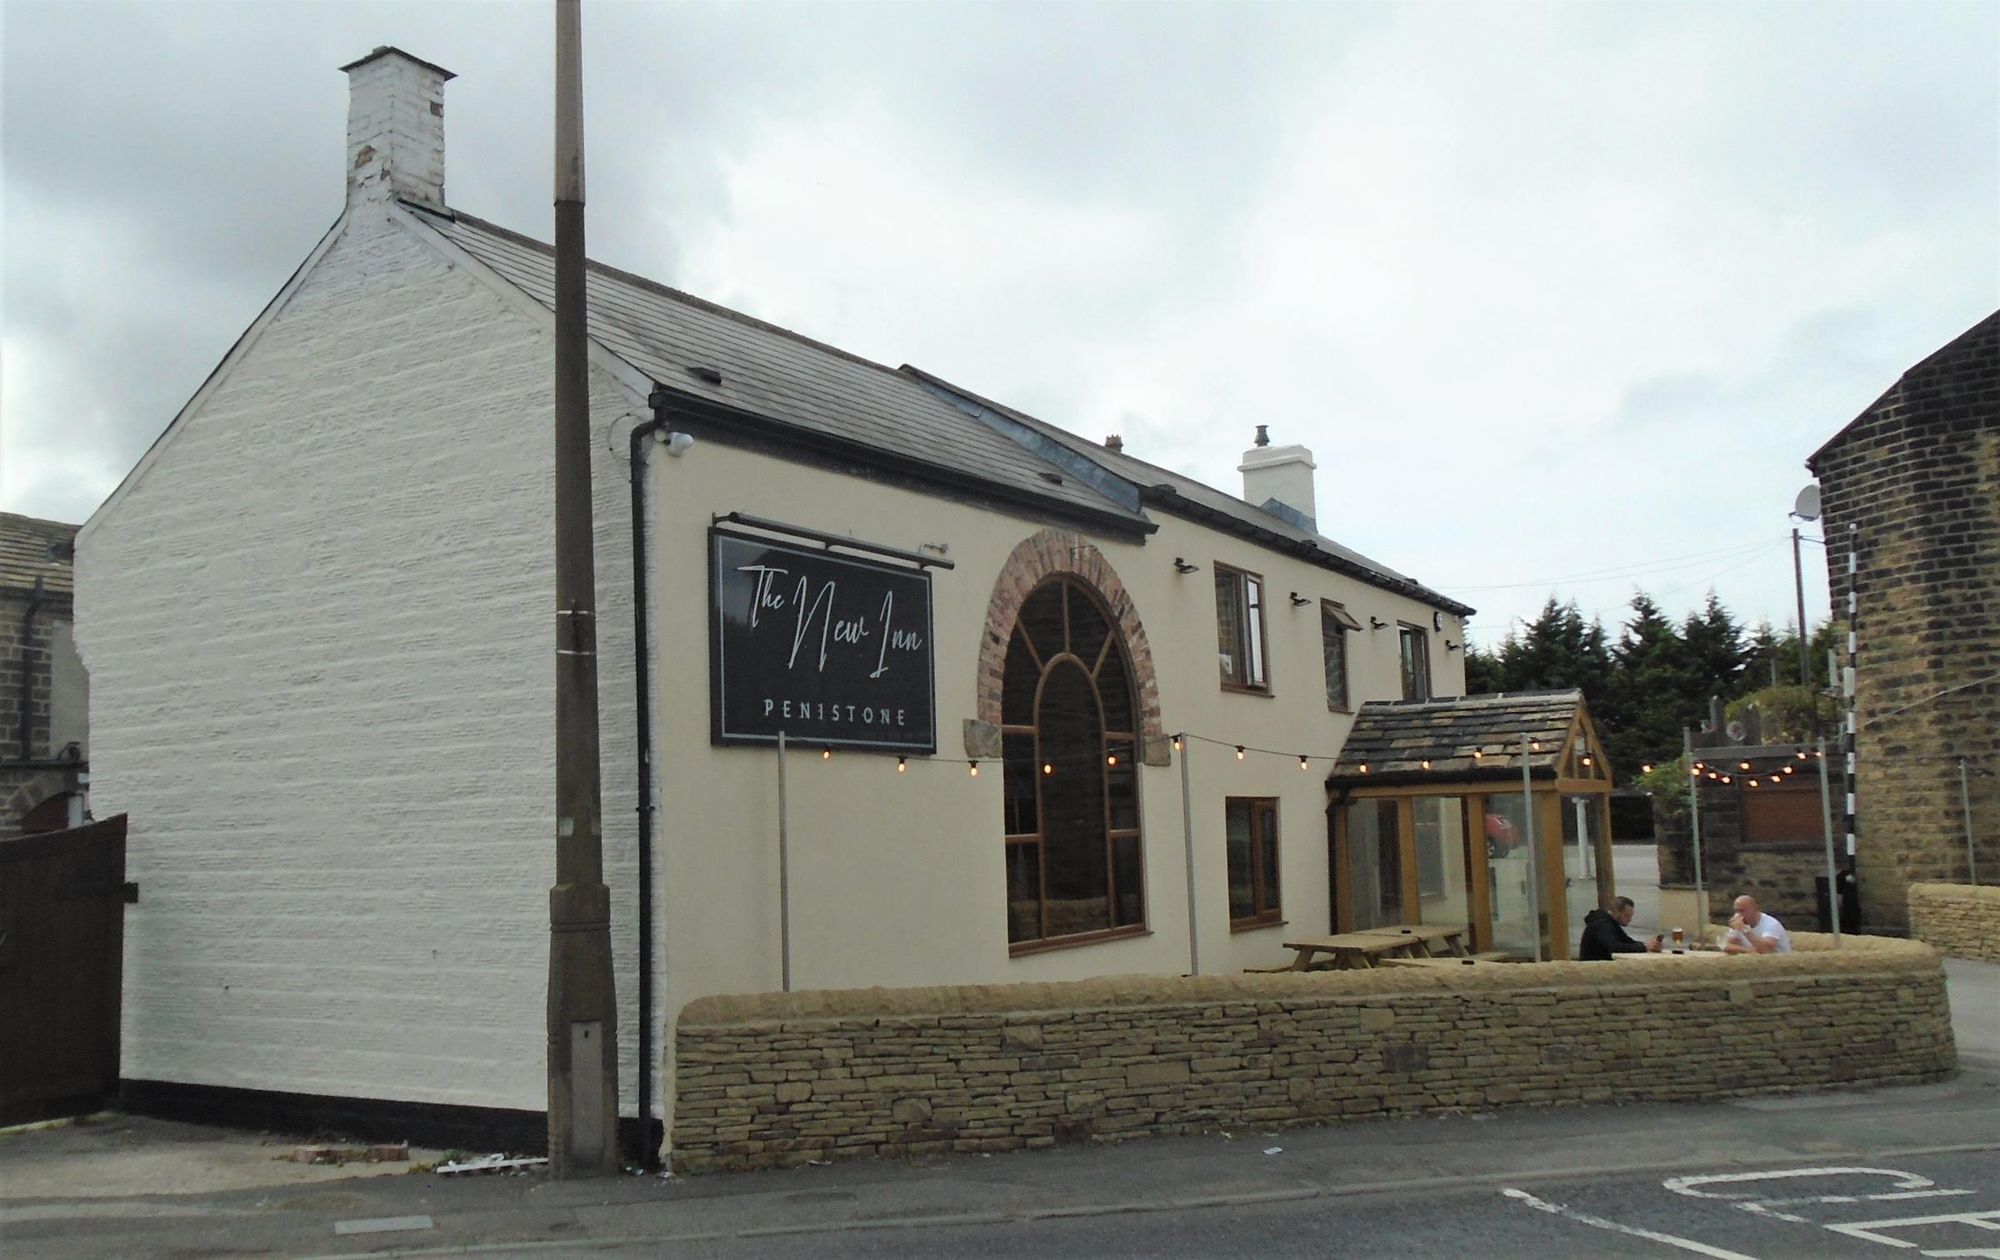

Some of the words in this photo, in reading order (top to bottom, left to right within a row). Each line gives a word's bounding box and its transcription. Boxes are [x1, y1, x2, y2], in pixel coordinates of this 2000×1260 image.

[737, 565, 789, 628] The
[788, 576, 870, 672] New
[869, 590, 922, 679] Inn
[763, 699, 905, 726] PENISTONE
